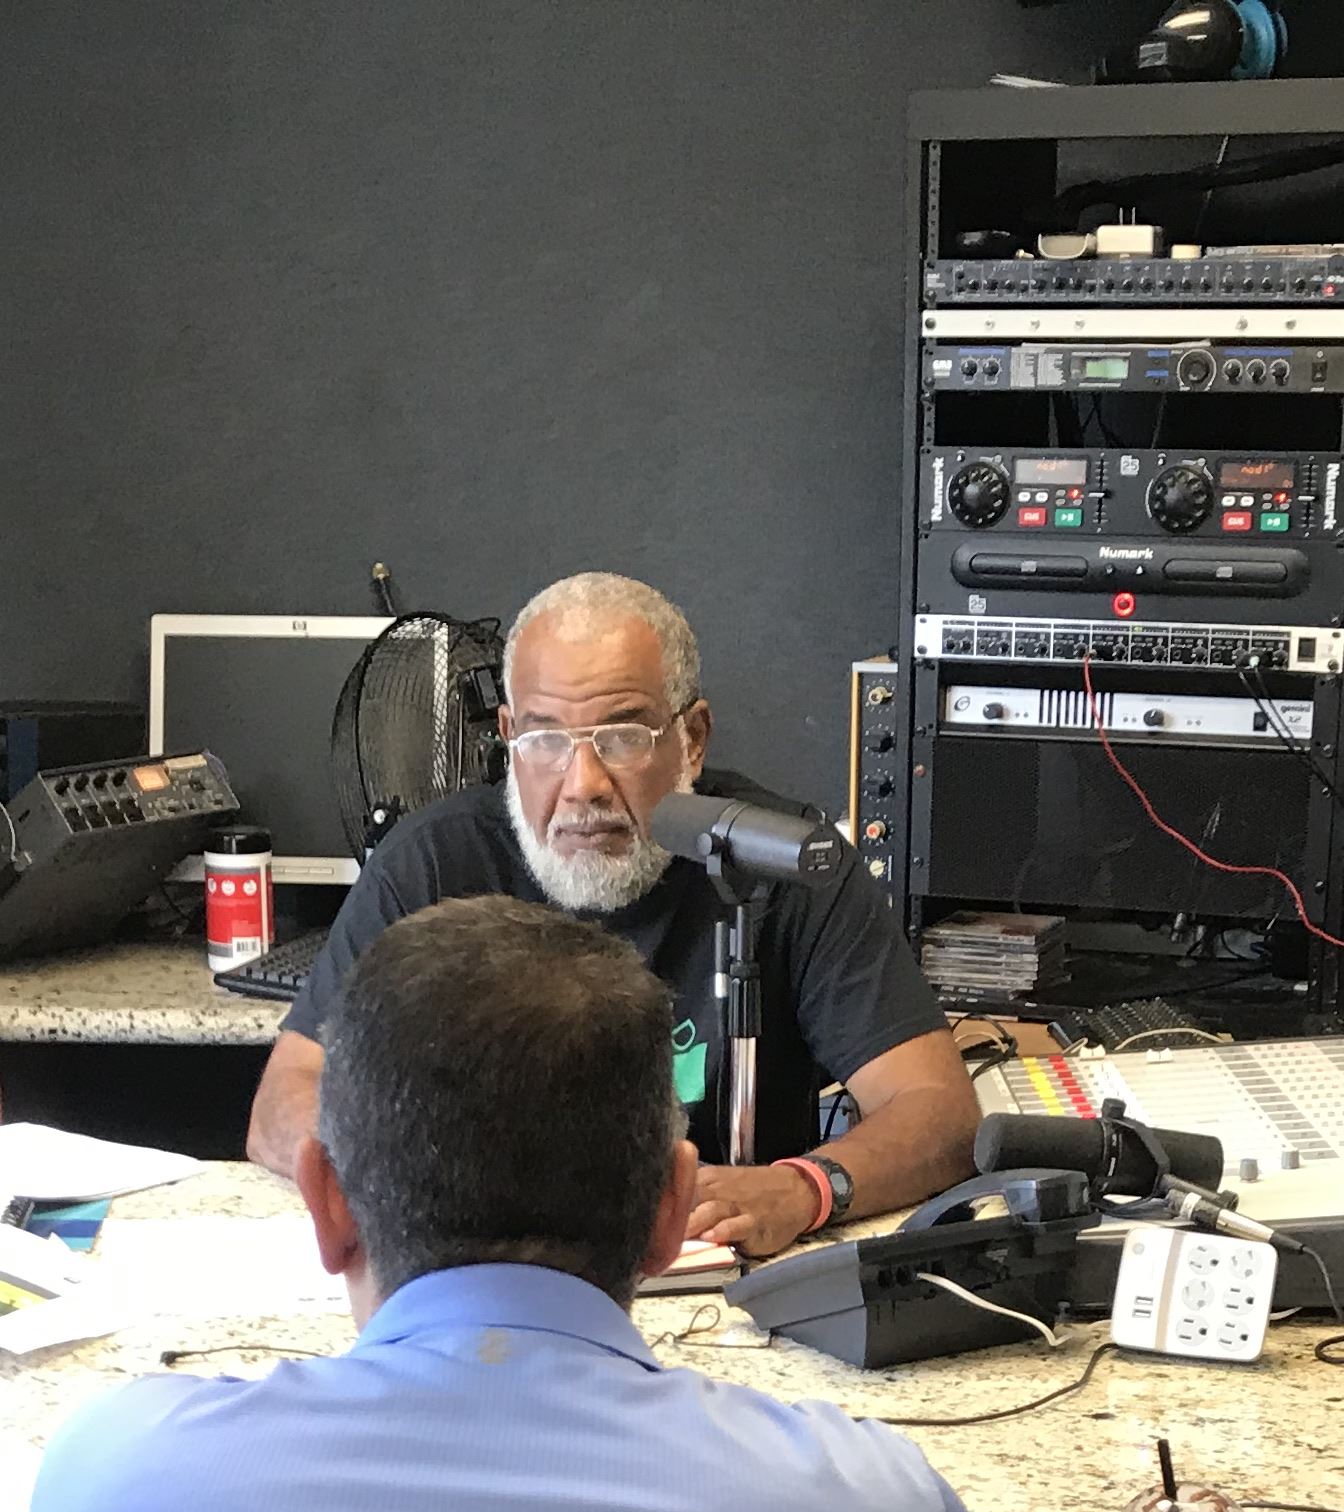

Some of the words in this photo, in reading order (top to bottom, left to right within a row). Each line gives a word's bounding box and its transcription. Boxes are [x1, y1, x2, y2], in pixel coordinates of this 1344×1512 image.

[931, 457, 945, 522] Numark
[1323, 463, 1341, 531] Numark
[1099, 547, 1154, 560] Numark
